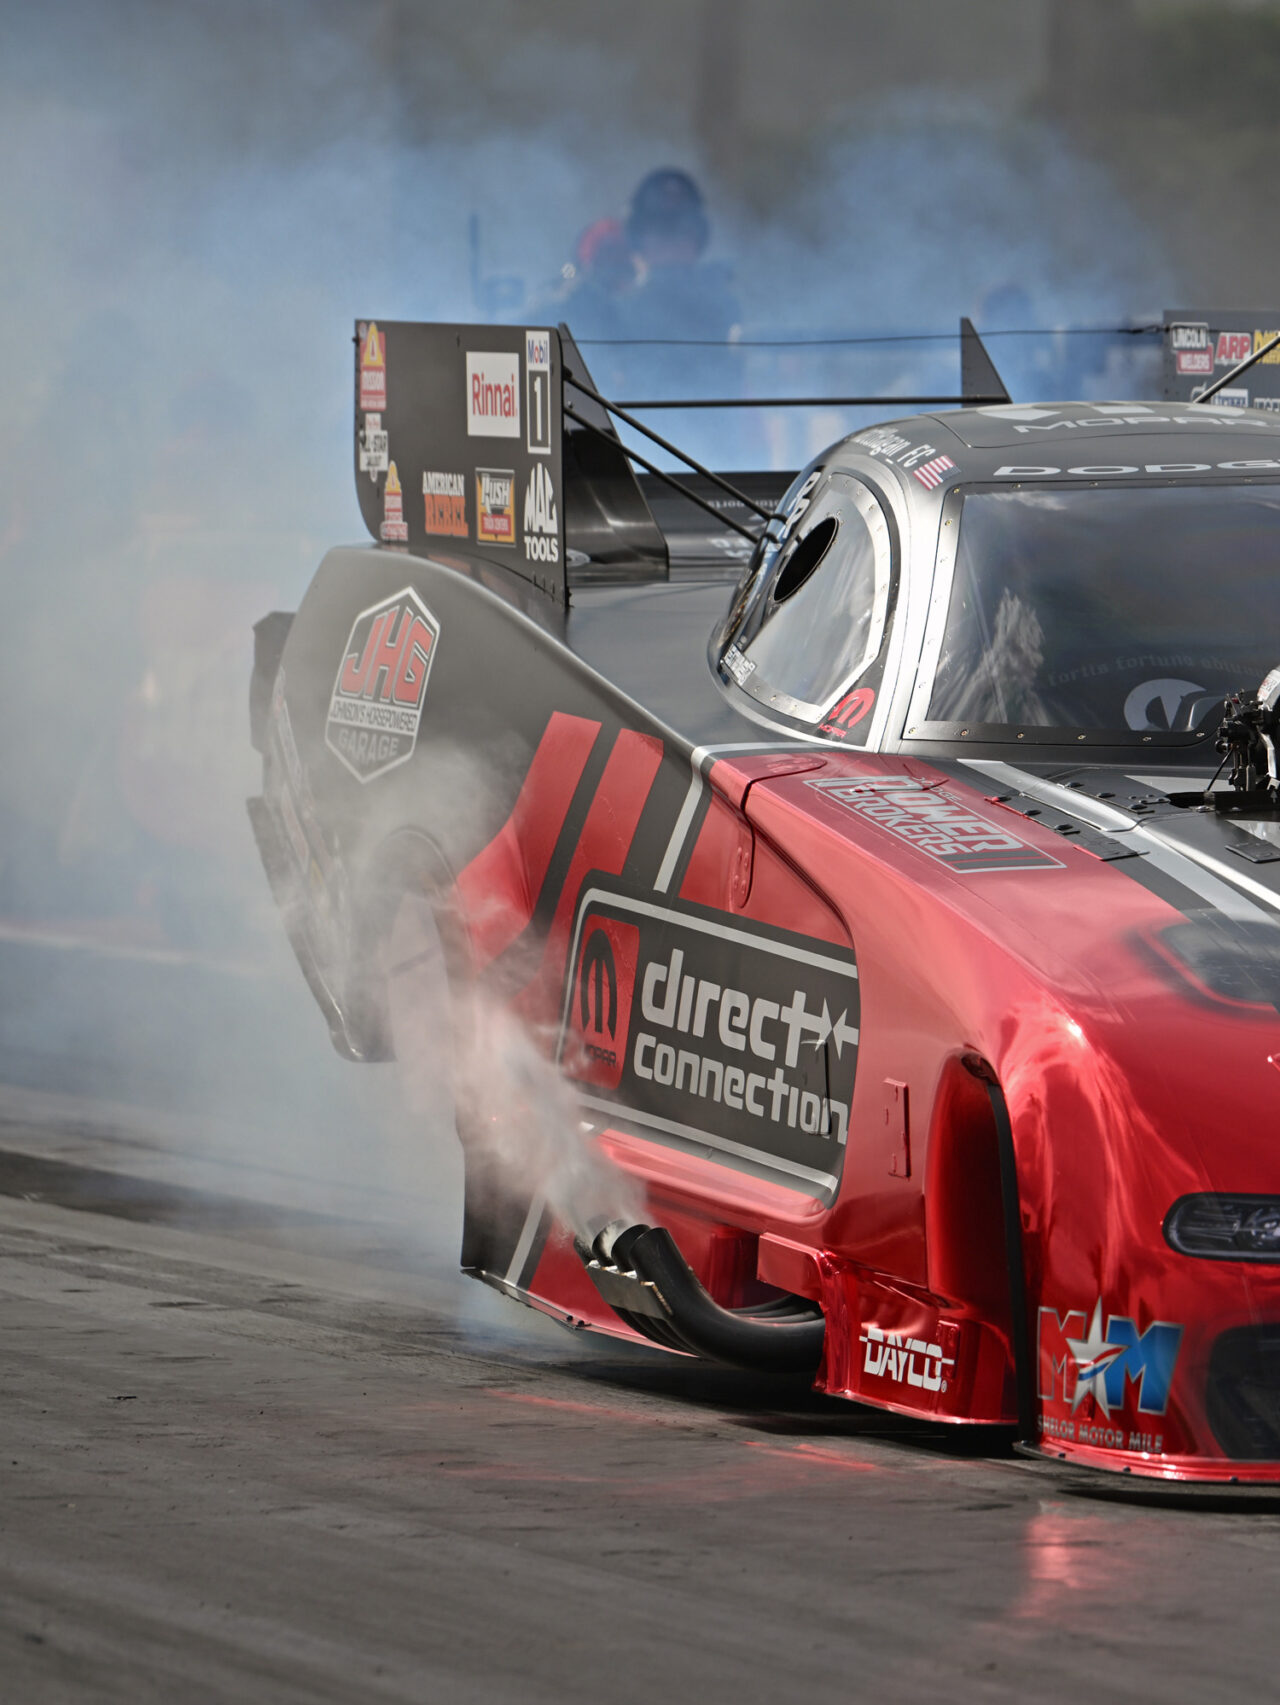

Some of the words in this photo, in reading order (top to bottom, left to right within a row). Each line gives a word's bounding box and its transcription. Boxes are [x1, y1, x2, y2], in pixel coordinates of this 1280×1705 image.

[527, 338, 549, 365] Mobil
[1172, 328, 1207, 348] LINCOLN
[1217, 335, 1251, 361] ARP
[472, 371, 515, 418] Rinnai
[533, 375, 543, 441] 1
[1013, 416, 1270, 434] MOPAR
[422, 470, 464, 497] AMERICAN
[481, 474, 511, 515] RUSH
[523, 462, 558, 534] MAC
[425, 494, 469, 538] REBEL
[523, 535, 559, 563] TOOLS
[338, 604, 435, 708] JHG
[338, 727, 400, 765] GARAGE
[813, 775, 1024, 851] POWER
[827, 787, 978, 856] BROKERS
[640, 948, 832, 1069] direct
[633, 1031, 849, 1146] connection
[859, 1325, 955, 1393] DAYCO
[1037, 1414, 1076, 1441] SHELOR
[1078, 1425, 1124, 1449] MOTOR
[1128, 1433, 1164, 1454] MILE
